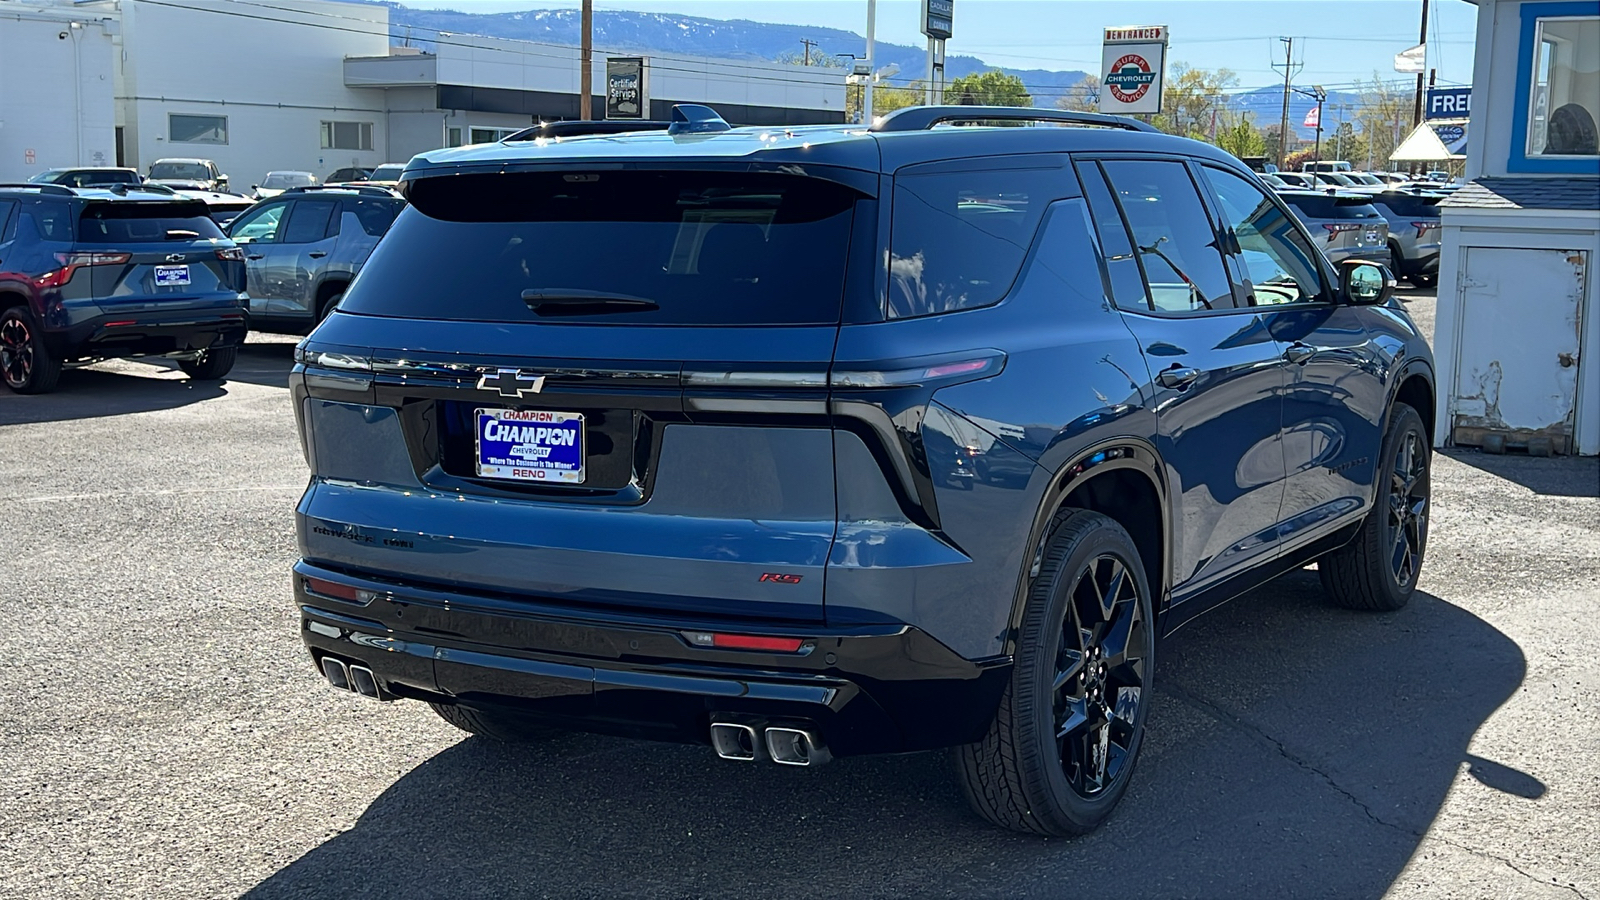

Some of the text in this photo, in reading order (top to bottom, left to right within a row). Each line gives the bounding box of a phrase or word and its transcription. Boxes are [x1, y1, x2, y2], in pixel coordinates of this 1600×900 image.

[1112, 29, 1154, 40] ENTRANCE
[1116, 55, 1146, 68] SUPER
[610, 78, 638, 88] Certified
[611, 88, 636, 98] Service
[1111, 86, 1147, 102] SERVICE
[503, 410, 553, 422] CHAMPION
[484, 420, 576, 446] CHAMPION
[512, 446, 549, 456] CHEVROLET
[512, 468, 546, 478] RENO
[758, 572, 804, 584] RS
